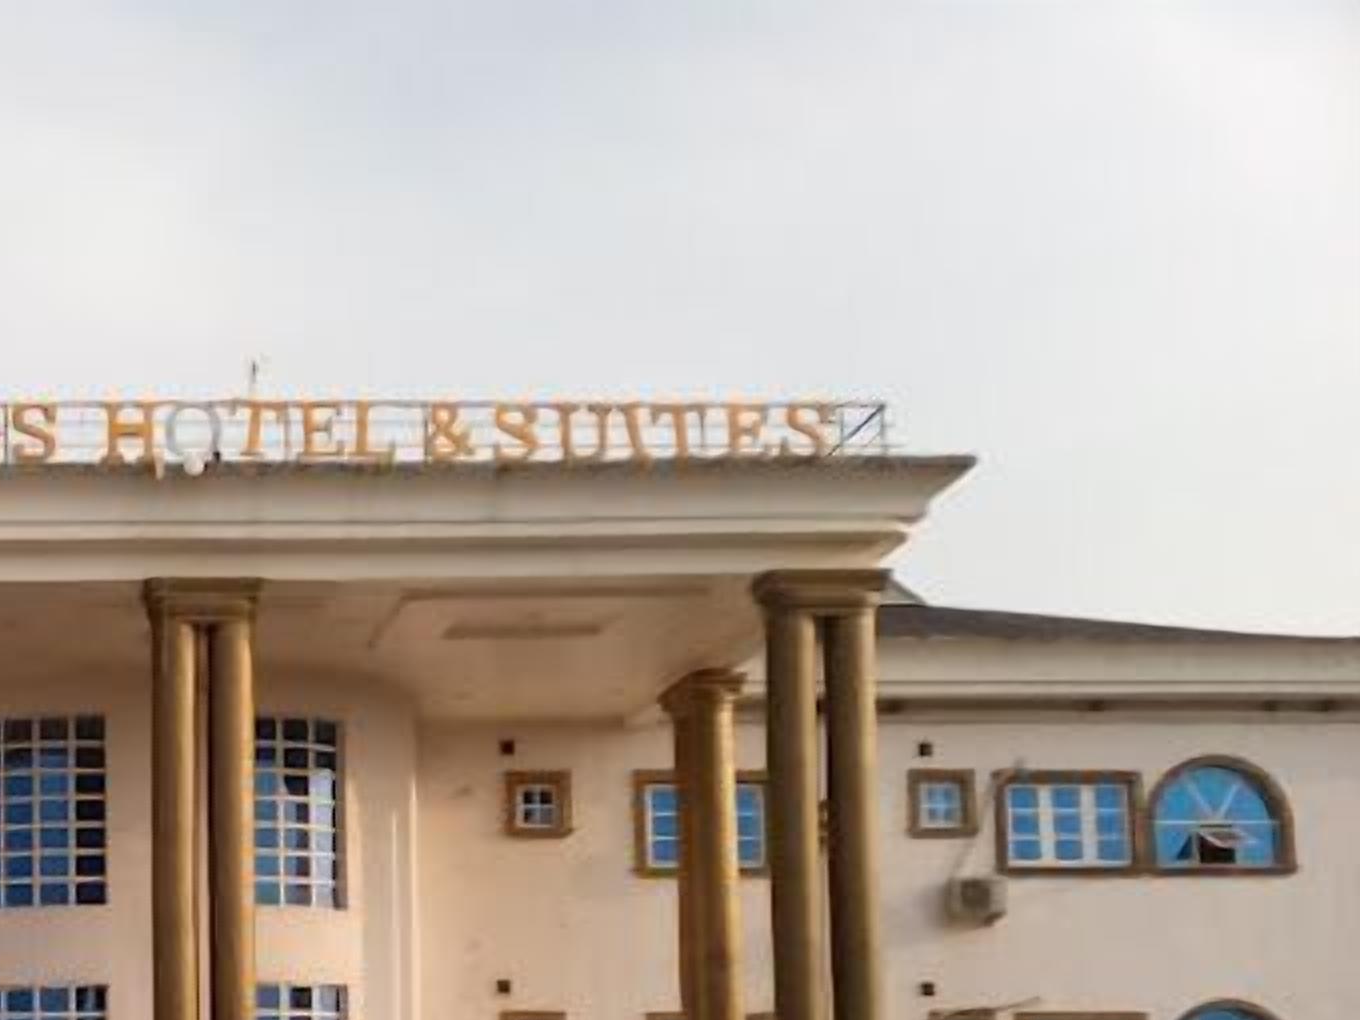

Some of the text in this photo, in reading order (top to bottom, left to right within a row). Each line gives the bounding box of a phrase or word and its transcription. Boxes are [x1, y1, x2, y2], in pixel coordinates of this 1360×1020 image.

[102, 402, 397, 468] HOTEL
[429, 403, 476, 464] &
[494, 403, 828, 467] SUITES
